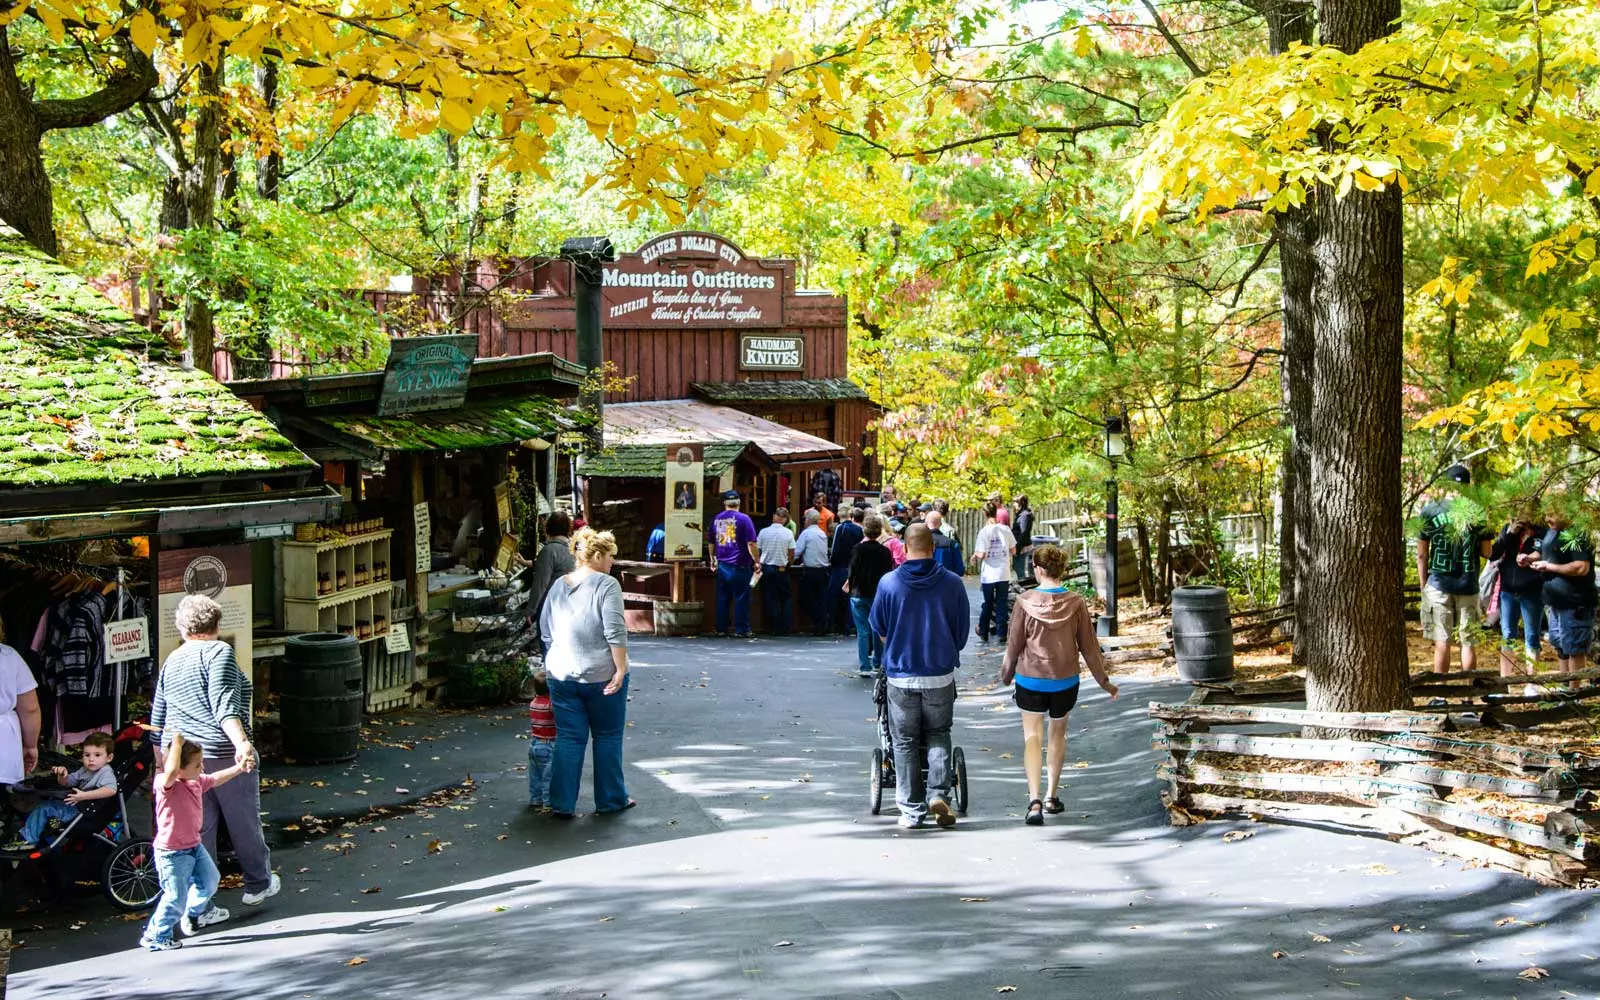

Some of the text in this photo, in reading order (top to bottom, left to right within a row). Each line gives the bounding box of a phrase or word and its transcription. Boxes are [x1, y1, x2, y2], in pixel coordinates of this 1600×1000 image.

[641, 236, 741, 266] SILVER DOLLAR CITY
[601, 268, 775, 289] Mountain Outfitters
[652, 290, 689, 307] Complete
[690, 290, 707, 304] line
[708, 291, 720, 307] of
[610, 297, 649, 318] FEATURING
[651, 306, 762, 323] Knives & Outdoor Supplies
[415, 345, 453, 361] ORIGINAL
[750, 339, 796, 350] HANDMADE
[746, 349, 799, 365] KNIVES
[398, 367, 460, 392] LYE SOAP
[112, 629, 142, 646] CLEARANCE
